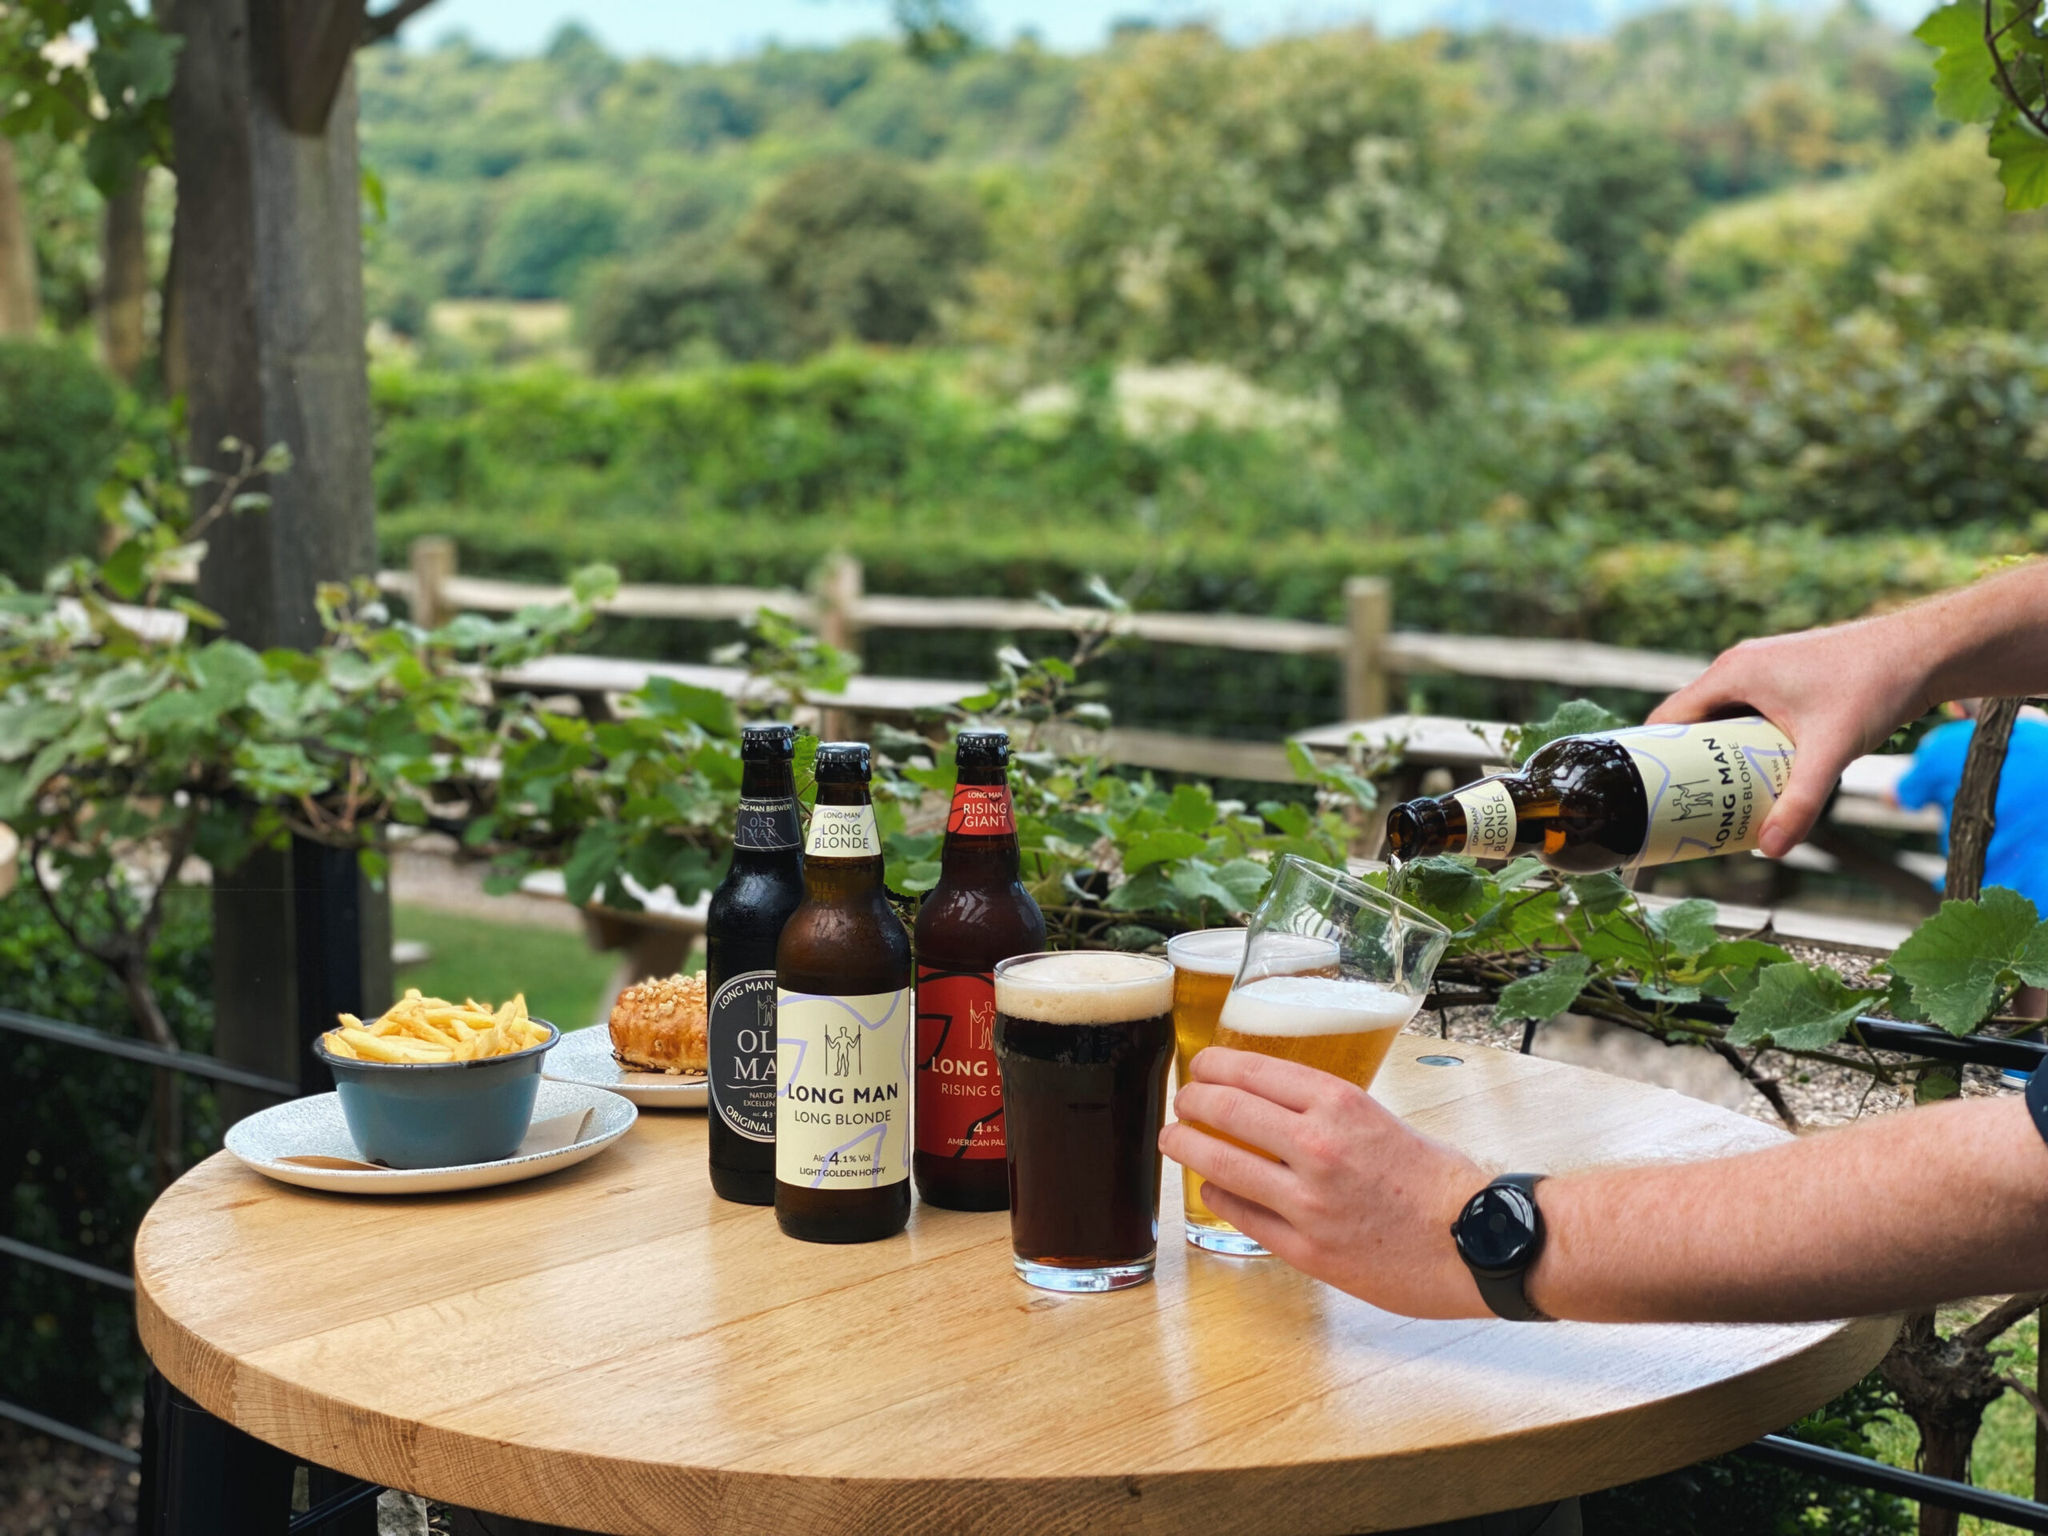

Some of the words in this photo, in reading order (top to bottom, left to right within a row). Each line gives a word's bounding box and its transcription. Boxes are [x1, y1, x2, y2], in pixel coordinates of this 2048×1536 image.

[1702, 738, 1734, 785] MAN
[1729, 742, 1753, 801] BLONDE
[968, 791, 987, 799] LONG
[766, 804, 793, 812] BREWERY
[963, 803, 1007, 815] RISING
[750, 817, 775, 828] OLD
[822, 823, 862, 836] LONG
[964, 815, 1006, 828] GIANT
[1482, 805, 1496, 847] LONG
[1492, 795, 1509, 852] BLONDE
[1709, 794, 1736, 850] LONG
[1735, 804, 1752, 841] LONG
[815, 837, 869, 849] BLONDE
[719, 985, 744, 1010] LONG
[745, 980, 774, 993] MAN
[737, 1029, 776, 1054] OL
[733, 1056, 776, 1081] MA
[931, 1056, 988, 1077] LONG
[788, 1083, 844, 1105] LONG
[853, 1082, 898, 1104] MAN
[941, 1083, 987, 1097] RISING
[726, 1105, 773, 1133] ORIGINAL
[794, 1110, 831, 1125] LONG
[835, 1109, 891, 1125] BLONDE
[947, 1138, 989, 1147] AMERICAN
[991, 1139, 1005, 1147] PAL
[800, 1167, 821, 1177] LIGHT
[823, 1169, 858, 1178] GOLDEN
[859, 1166, 887, 1176] HOPPY
